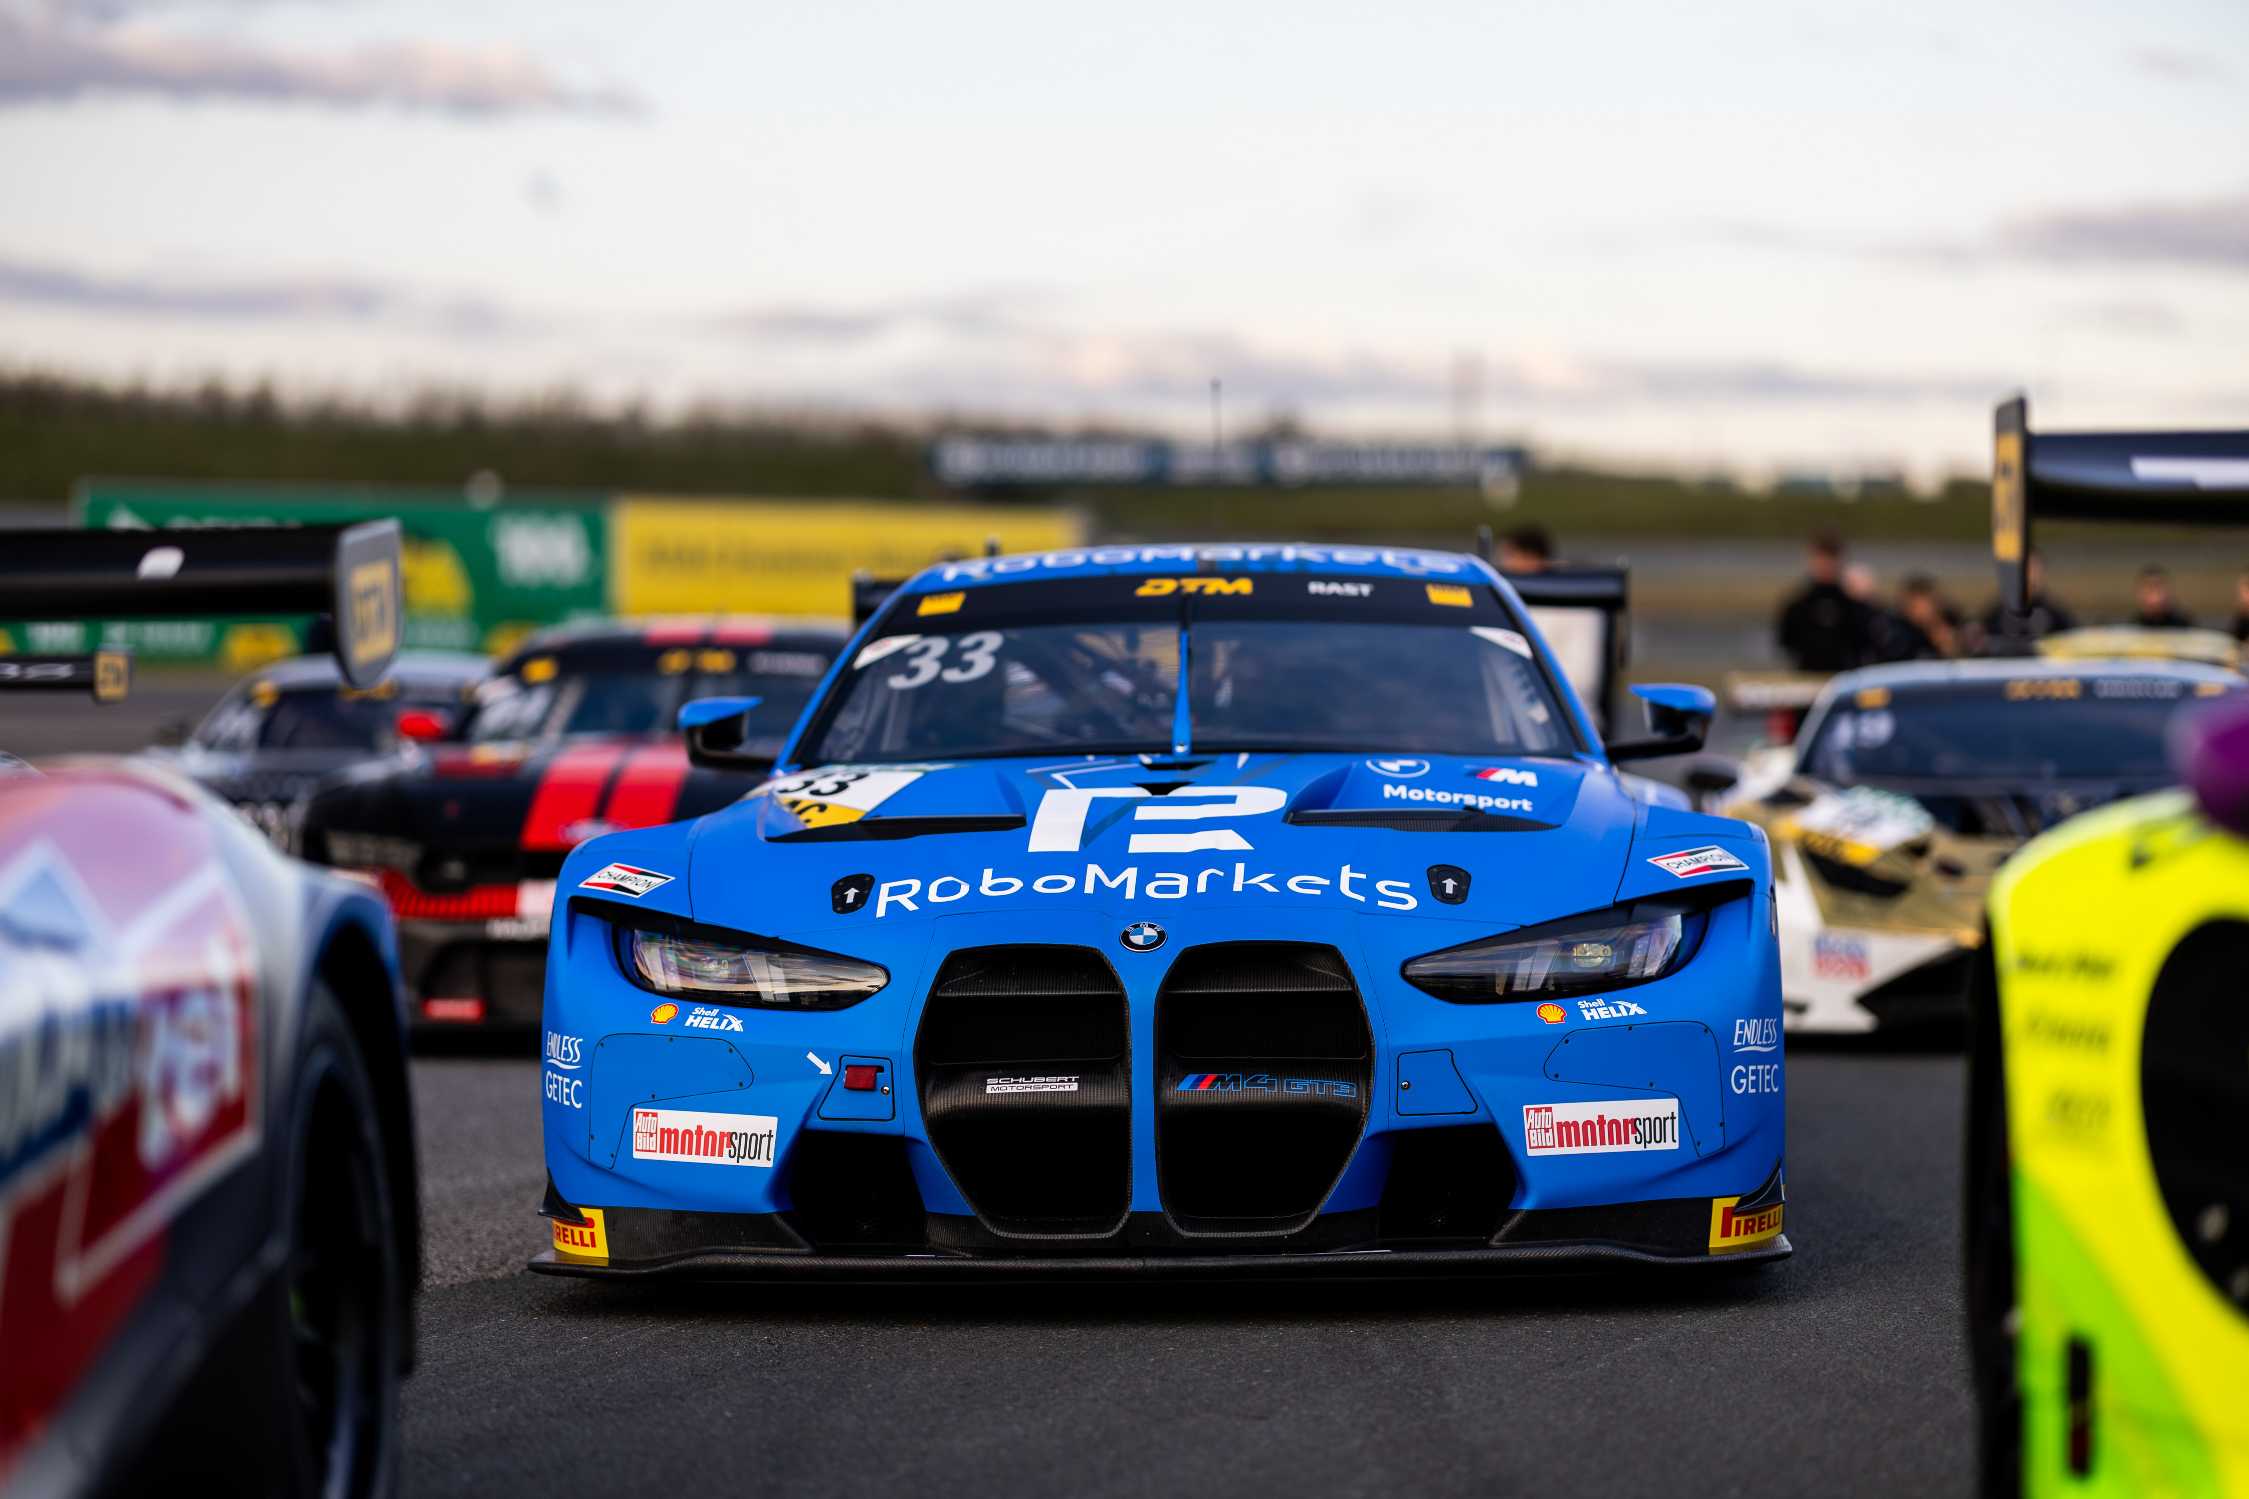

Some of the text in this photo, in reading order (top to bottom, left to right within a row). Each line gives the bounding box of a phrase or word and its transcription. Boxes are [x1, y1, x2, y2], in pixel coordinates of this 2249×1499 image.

[1135, 578, 1253, 596] DTM
[1308, 581, 1373, 597] RAST
[887, 631, 1003, 690] 33
[1383, 783, 1533, 812] Motorsport
[875, 862, 1418, 918] RoboMarkets
[694, 1007, 719, 1017] Shell
[1577, 999, 1605, 1010] Shell
[1581, 1001, 1648, 1021] HELIX
[685, 1013, 744, 1032] HELIX
[1733, 1018, 1778, 1046] ENDLESS
[546, 1031, 583, 1063] ENDLESS
[545, 1070, 583, 1108] GETEC
[986, 1076, 1079, 1084] SCHUBERT
[988, 1084, 1077, 1093] MOTORSPORT
[1177, 1073, 1357, 1098] M4 GT3
[1731, 1064, 1779, 1094] GETEC
[635, 1112, 657, 1133] Auto
[1527, 1108, 1553, 1129] Auto
[1556, 1112, 1677, 1148] motorsport
[659, 1124, 774, 1163] motorsport
